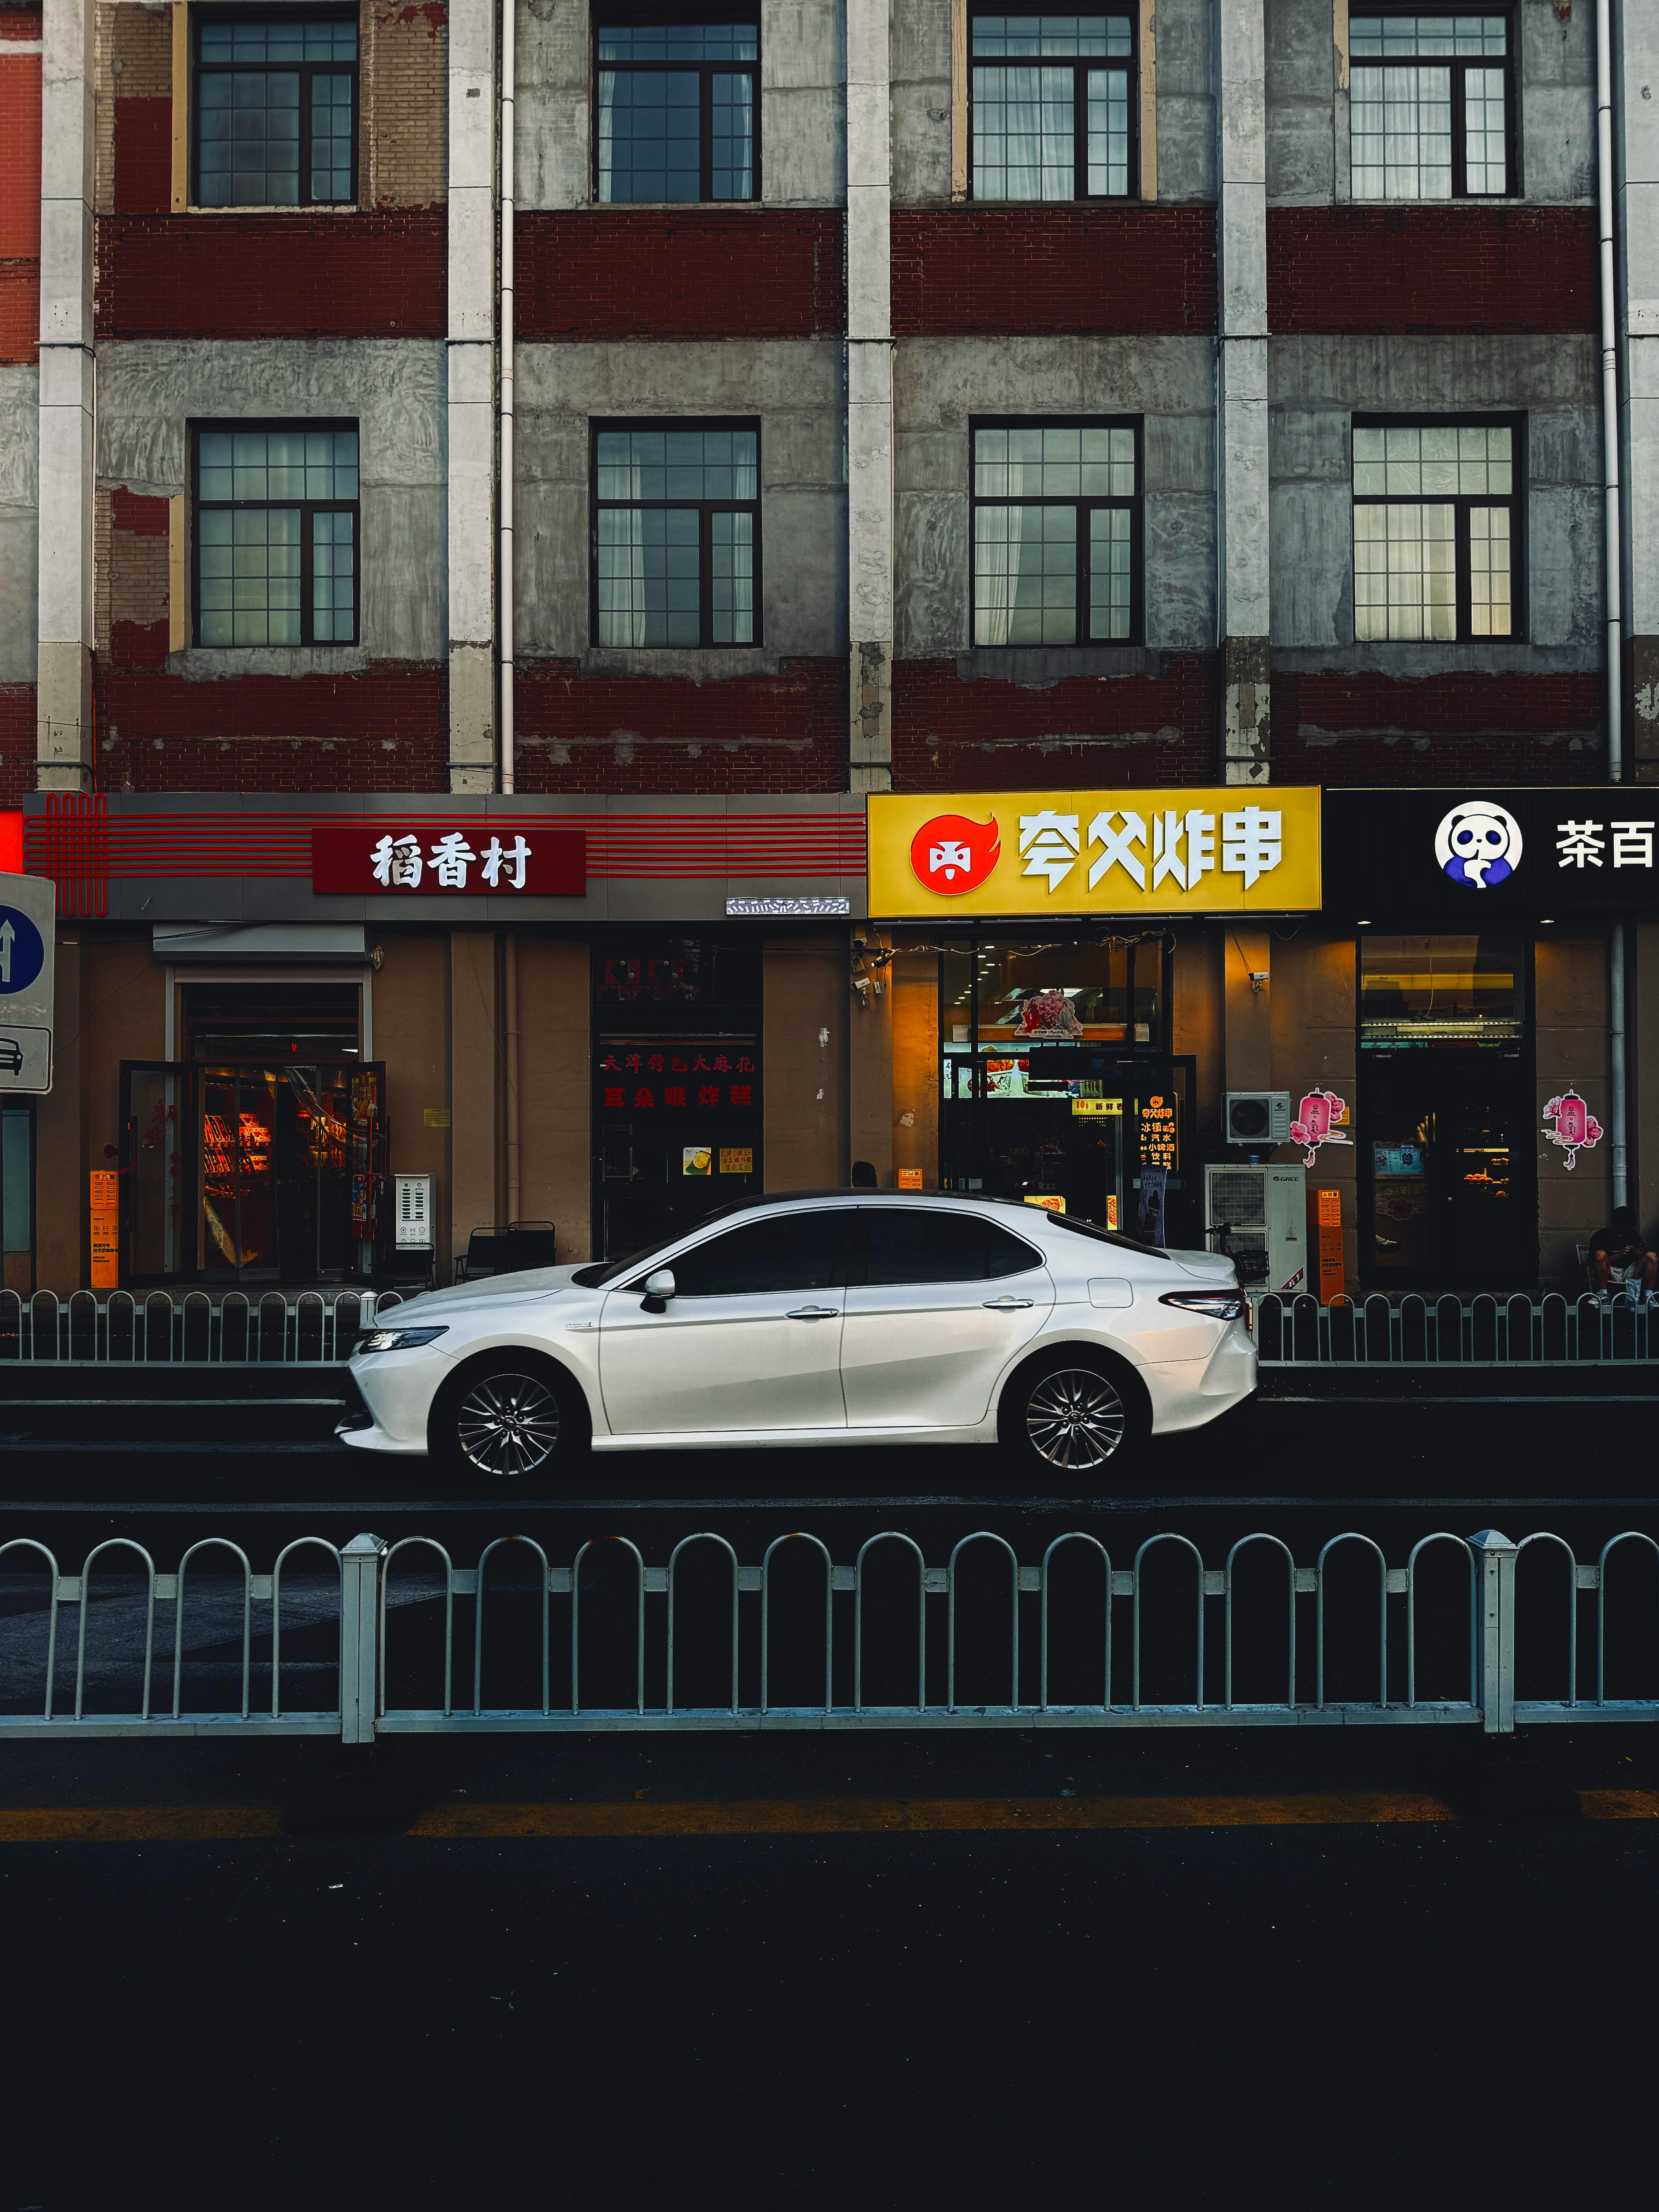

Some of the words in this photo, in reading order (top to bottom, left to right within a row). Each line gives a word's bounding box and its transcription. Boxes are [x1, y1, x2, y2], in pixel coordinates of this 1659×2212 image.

[1019, 806, 1282, 893] 夸父炸串
[1556, 820, 1655, 868] 茶百
[370, 831, 532, 889] 稻香村
[603, 1053, 755, 1073] 天津特色大麻花
[604, 1085, 752, 1108] 耳朵眼炸糕
[1142, 1108, 1172, 1119] 夸父炸串
[1141, 1122, 1161, 1132] 冰镇
